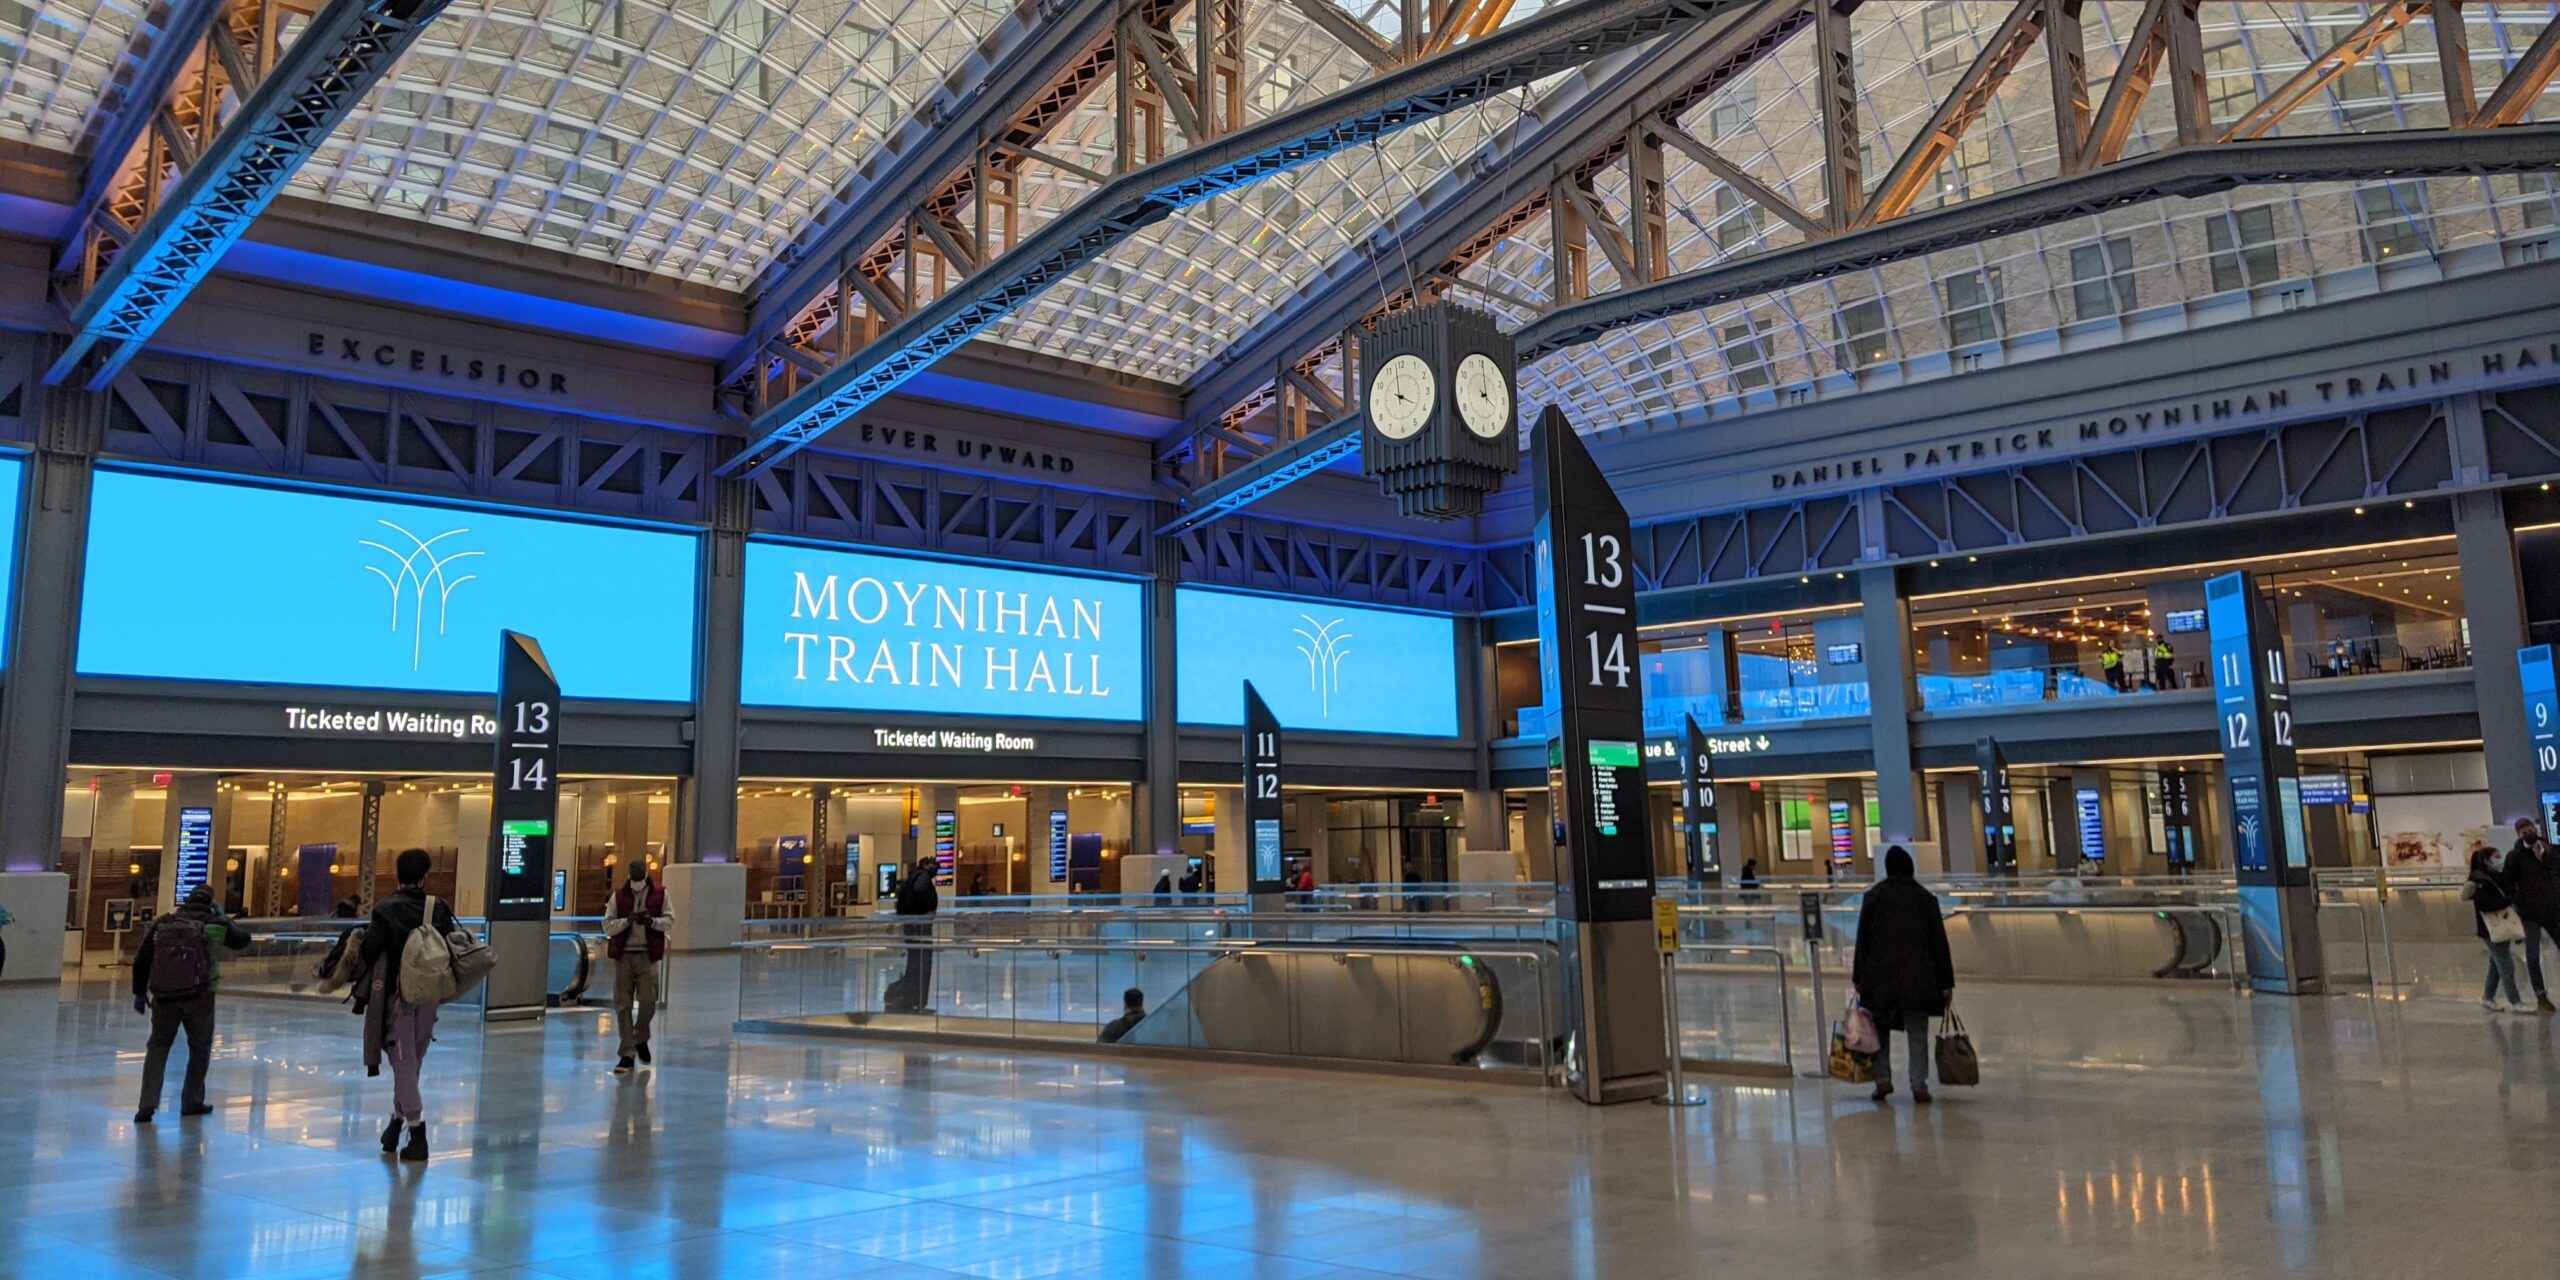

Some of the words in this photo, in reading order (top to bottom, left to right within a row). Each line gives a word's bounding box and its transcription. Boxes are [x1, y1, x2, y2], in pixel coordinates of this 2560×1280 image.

[308, 333, 567, 393] EXCELSIOR
[1771, 457, 1883, 490] DANIEL
[1904, 429, 2053, 468] PATRICK
[2079, 388, 2288, 441] MOYNIHAN
[2315, 361, 2450, 401] TRAIN
[861, 424, 937, 451] EVER
[957, 440, 1074, 473] UPWARD
[1581, 532, 1623, 588] 13
[790, 571, 1102, 641] MOYNIHAN
[784, 632, 963, 688] TRAIN
[984, 647, 1110, 696] HALL
[1586, 630, 1631, 687] 14
[2222, 652, 2240, 688] 11
[2267, 649, 2284, 685] 11
[285, 708, 379, 731] Ticketed
[386, 712, 465, 738] Waiting
[471, 715, 497, 735] Ro
[514, 701, 549, 734] 13
[2273, 710, 2293, 746] 12
[2535, 702, 2548, 728] 9
[874, 729, 936, 748] Ticketed
[940, 731, 992, 752] Waiting
[995, 733, 1034, 750] Room
[2227, 712, 2250, 749] 12
[1257, 732, 1275, 757] 11
[1664, 741, 1675, 756] &
[1708, 737, 1751, 754] Street
[1680, 755, 1686, 775] 9
[1698, 754, 1708, 774] 9
[2538, 746, 2557, 772] 10
[509, 758, 548, 791] 14
[1257, 774, 1278, 798] 12
[1982, 770, 1987, 786] 7
[2000, 769, 2006, 786] 7
[2163, 778, 2170, 793] 5
[2180, 777, 2186, 793] 5
[1700, 787, 1713, 807] 10
[1984, 797, 1991, 813] 8
[2002, 796, 2010, 813] 8
[2165, 801, 2172, 816] 6
[2181, 801, 2189, 816] 6
